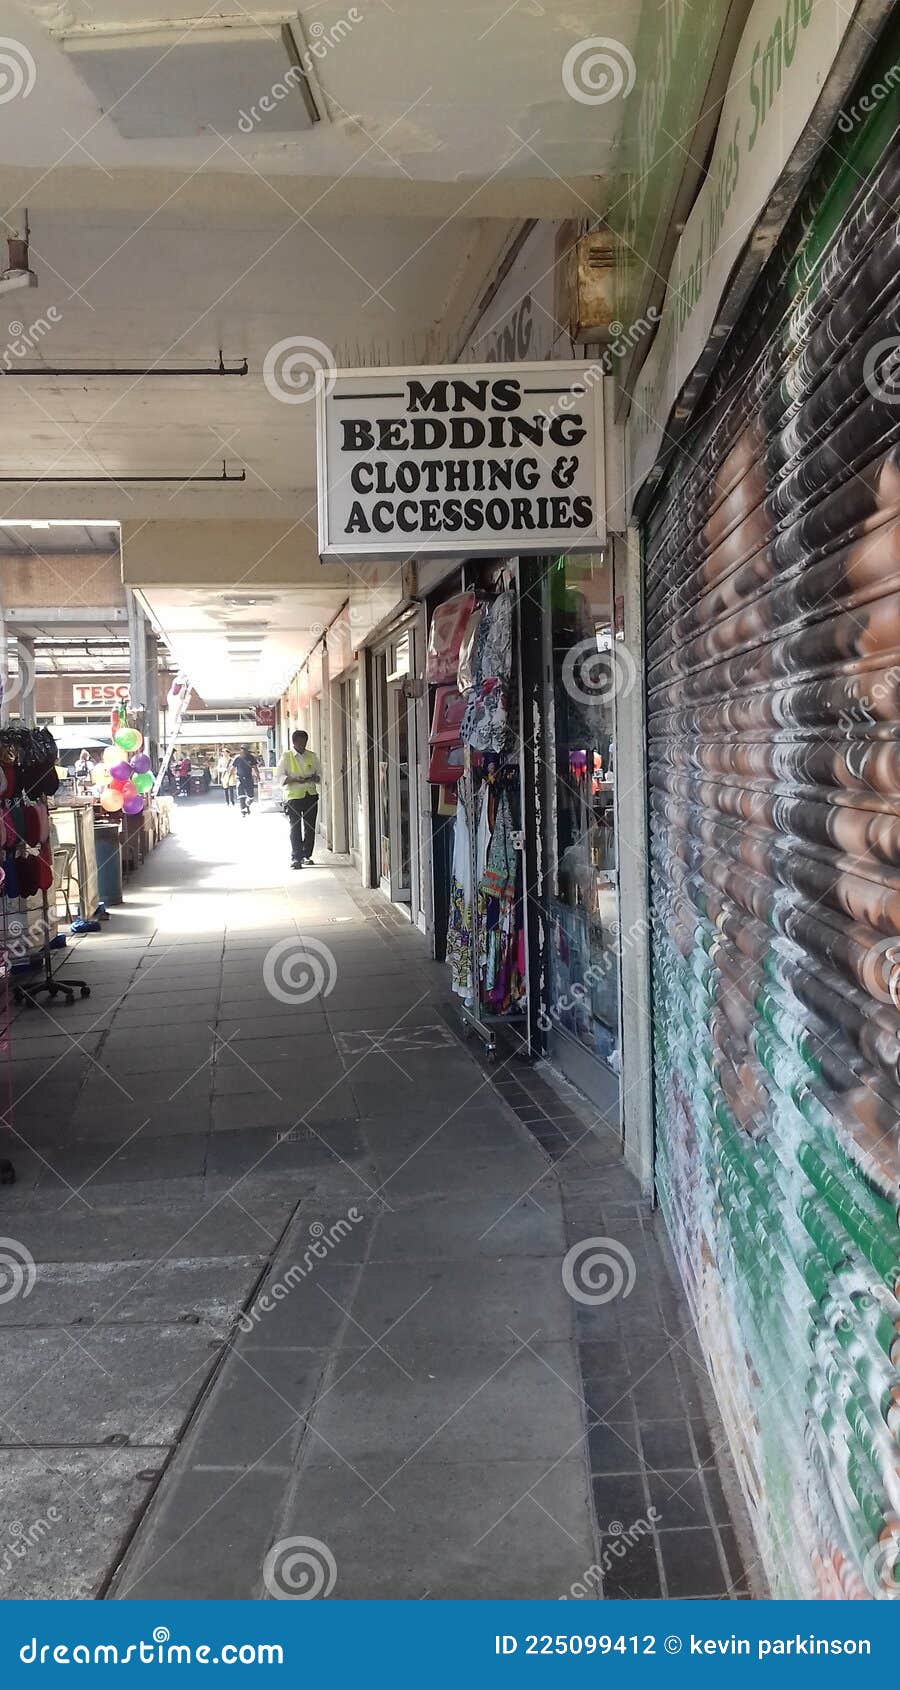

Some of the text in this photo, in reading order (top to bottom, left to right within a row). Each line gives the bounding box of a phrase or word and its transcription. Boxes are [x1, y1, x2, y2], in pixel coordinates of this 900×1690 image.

[406, 379, 522, 413] MNS
[340, 414, 587, 452] BEDDING
[351, 456, 579, 495] CLOTHING &
[344, 496, 593, 534] ACCESSORIES
[76, 686, 128, 699] TESC
